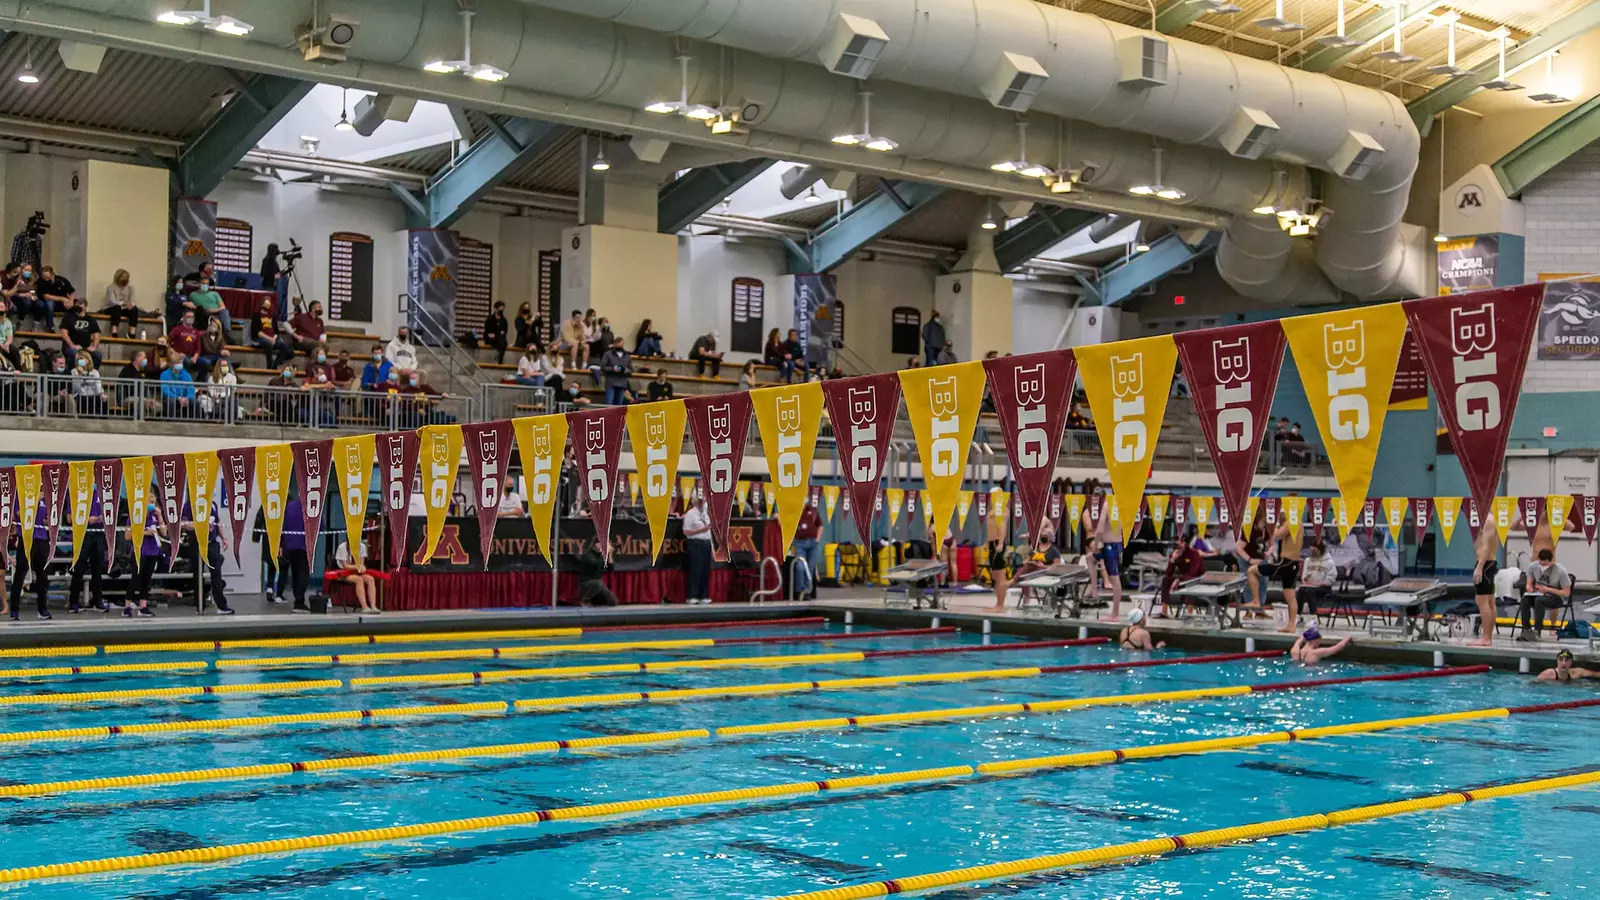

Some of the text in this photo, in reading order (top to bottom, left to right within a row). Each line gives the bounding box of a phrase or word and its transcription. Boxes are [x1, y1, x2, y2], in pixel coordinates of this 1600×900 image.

[1442, 267, 1495, 279] CHAMPIONS
[1451, 257, 1483, 270] NCAA
[1324, 320, 1370, 441] B1G
[1451, 303, 1501, 431] B1G
[1554, 335, 1600, 345] SPEEDO
[848, 386, 877, 482] B1G
[928, 376, 960, 476] B1G
[1014, 363, 1049, 469] B1G
[1110, 353, 1147, 463] B1G
[1212, 337, 1253, 452] B1G
[389, 436, 404, 509] B1G
[430, 433, 449, 508] B1G
[479, 430, 498, 507] B1G
[532, 424, 550, 504] B1G
[585, 417, 608, 500] B1G
[644, 411, 668, 497] B1G
[708, 403, 732, 493] B1G
[776, 395, 801, 487] B1G
[492, 538, 585, 555] NIVEITY
[615, 534, 688, 554] MINES
